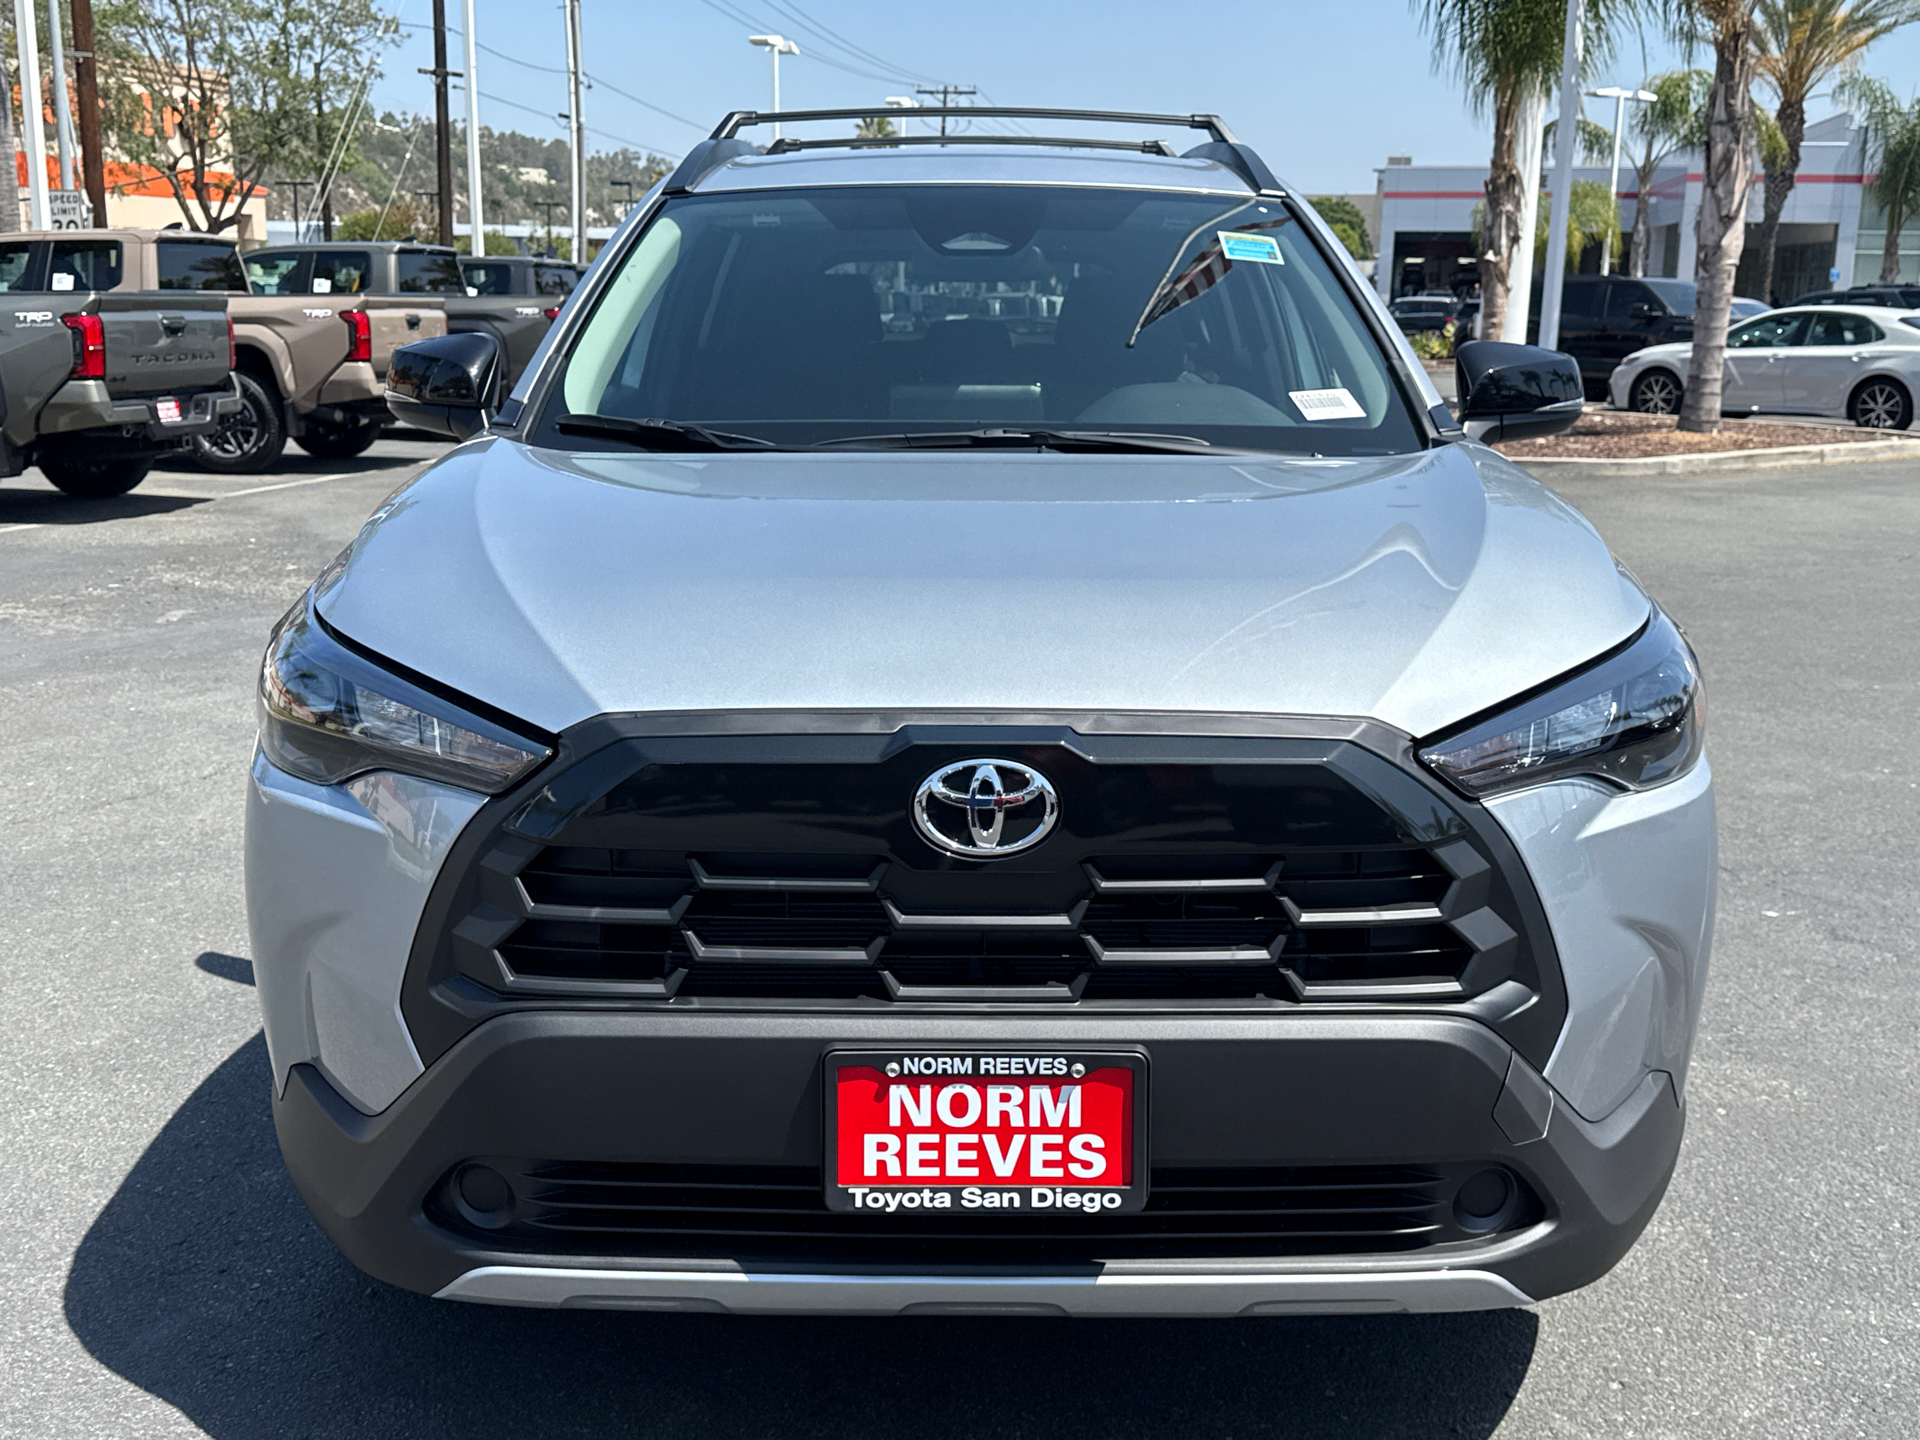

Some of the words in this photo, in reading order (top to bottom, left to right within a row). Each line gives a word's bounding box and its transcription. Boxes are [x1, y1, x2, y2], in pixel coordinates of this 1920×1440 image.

[51, 206, 77, 216] LIMIT
[14, 311, 53, 323] TRD
[302, 308, 332, 319] TRD
[131, 352, 216, 367] TACOMA
[903, 1057, 972, 1075] NORM
[979, 1057, 1067, 1075] REEVES
[888, 1083, 1082, 1128] NORM
[863, 1133, 1107, 1178] REEVES
[848, 1187, 952, 1213] Toyota
[960, 1187, 1020, 1209] San
[1030, 1187, 1122, 1213] Diego
